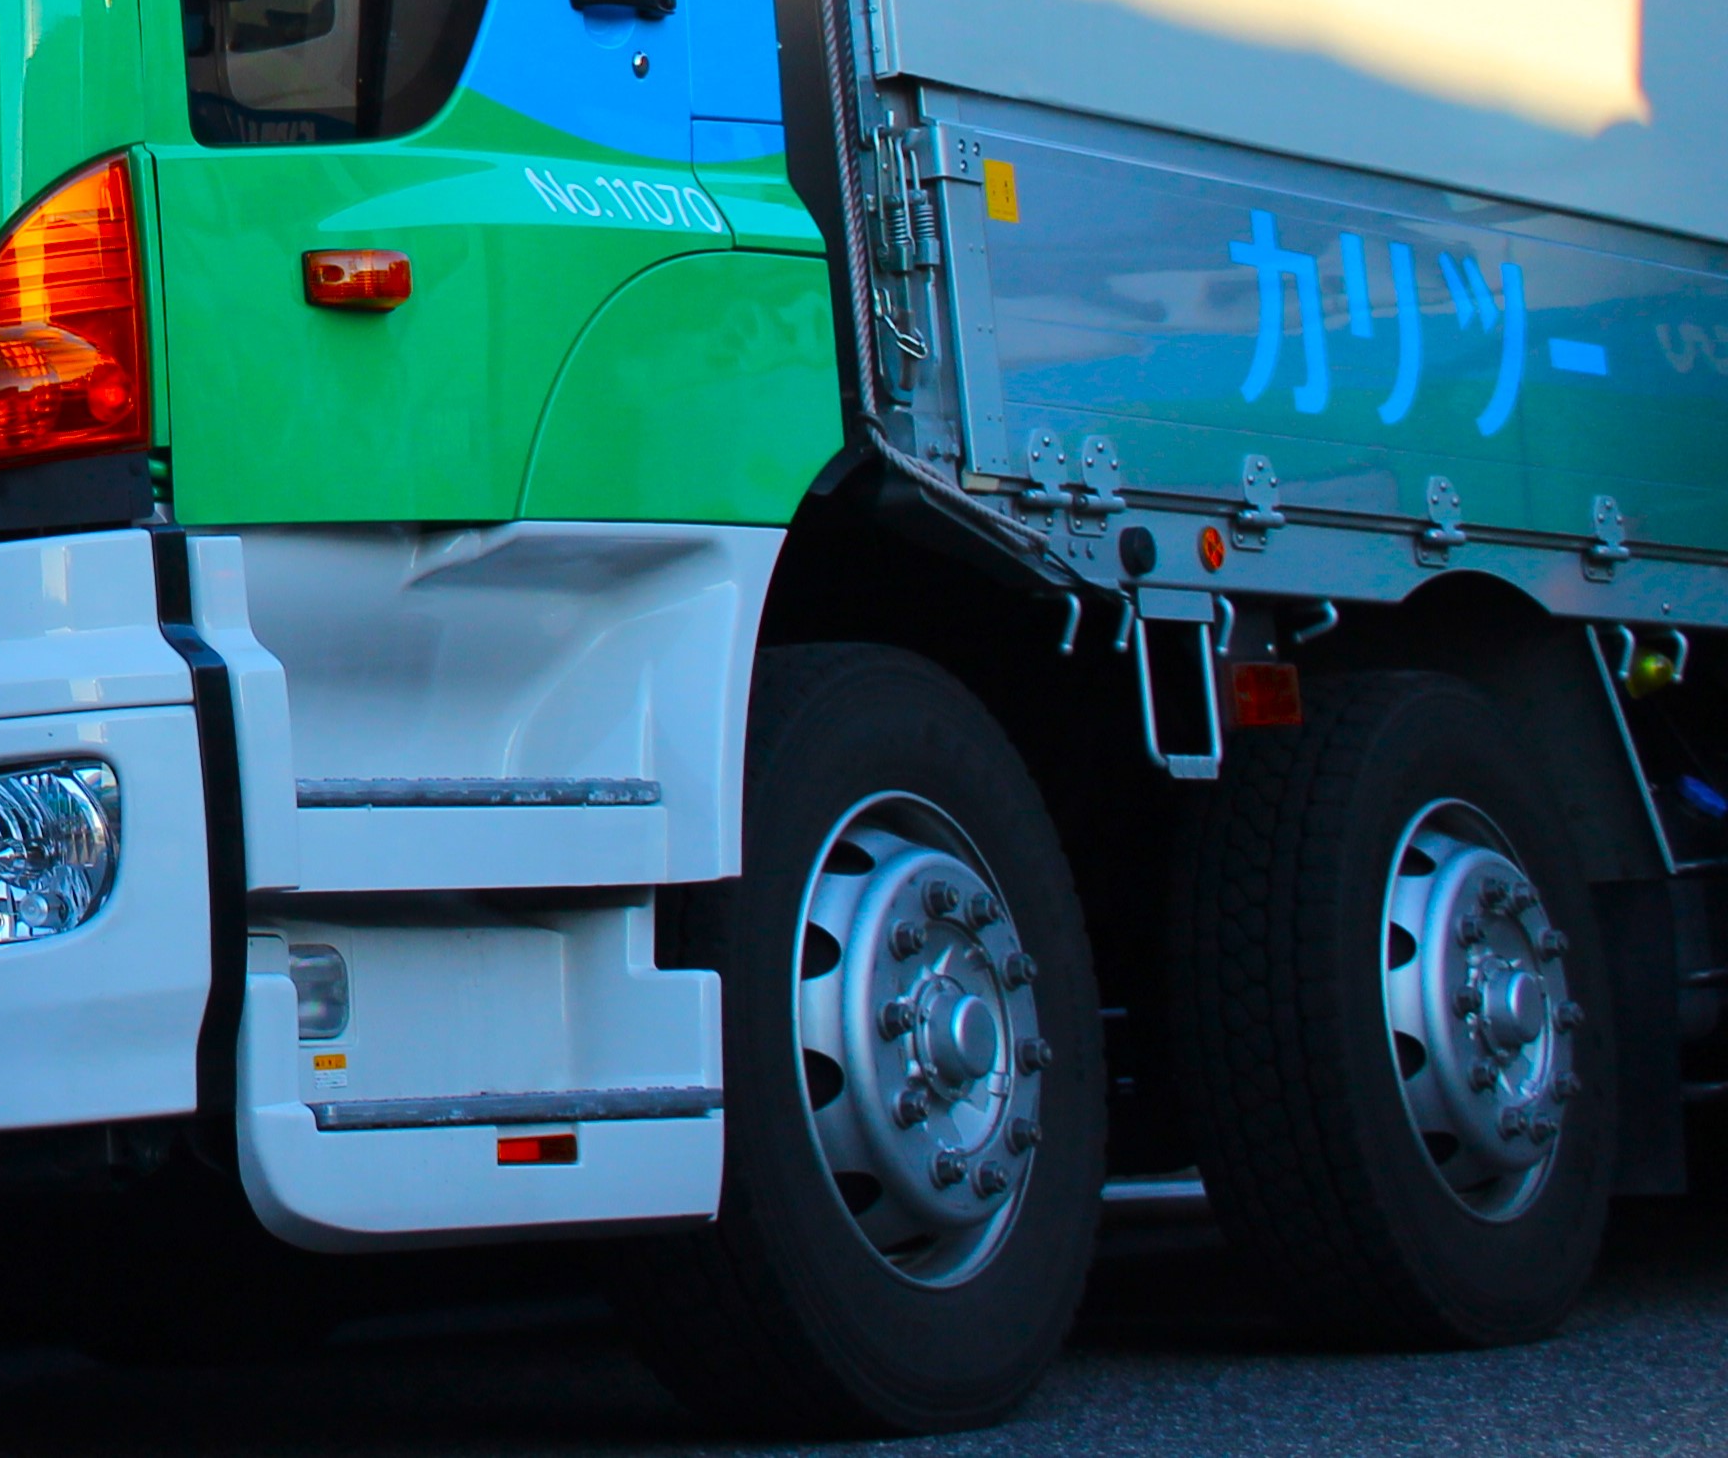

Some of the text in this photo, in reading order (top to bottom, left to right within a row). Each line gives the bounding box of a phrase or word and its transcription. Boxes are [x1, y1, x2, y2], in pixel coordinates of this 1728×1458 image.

[524, 166, 723, 233] No.11070
[1228, 207, 1609, 438] カリツー
